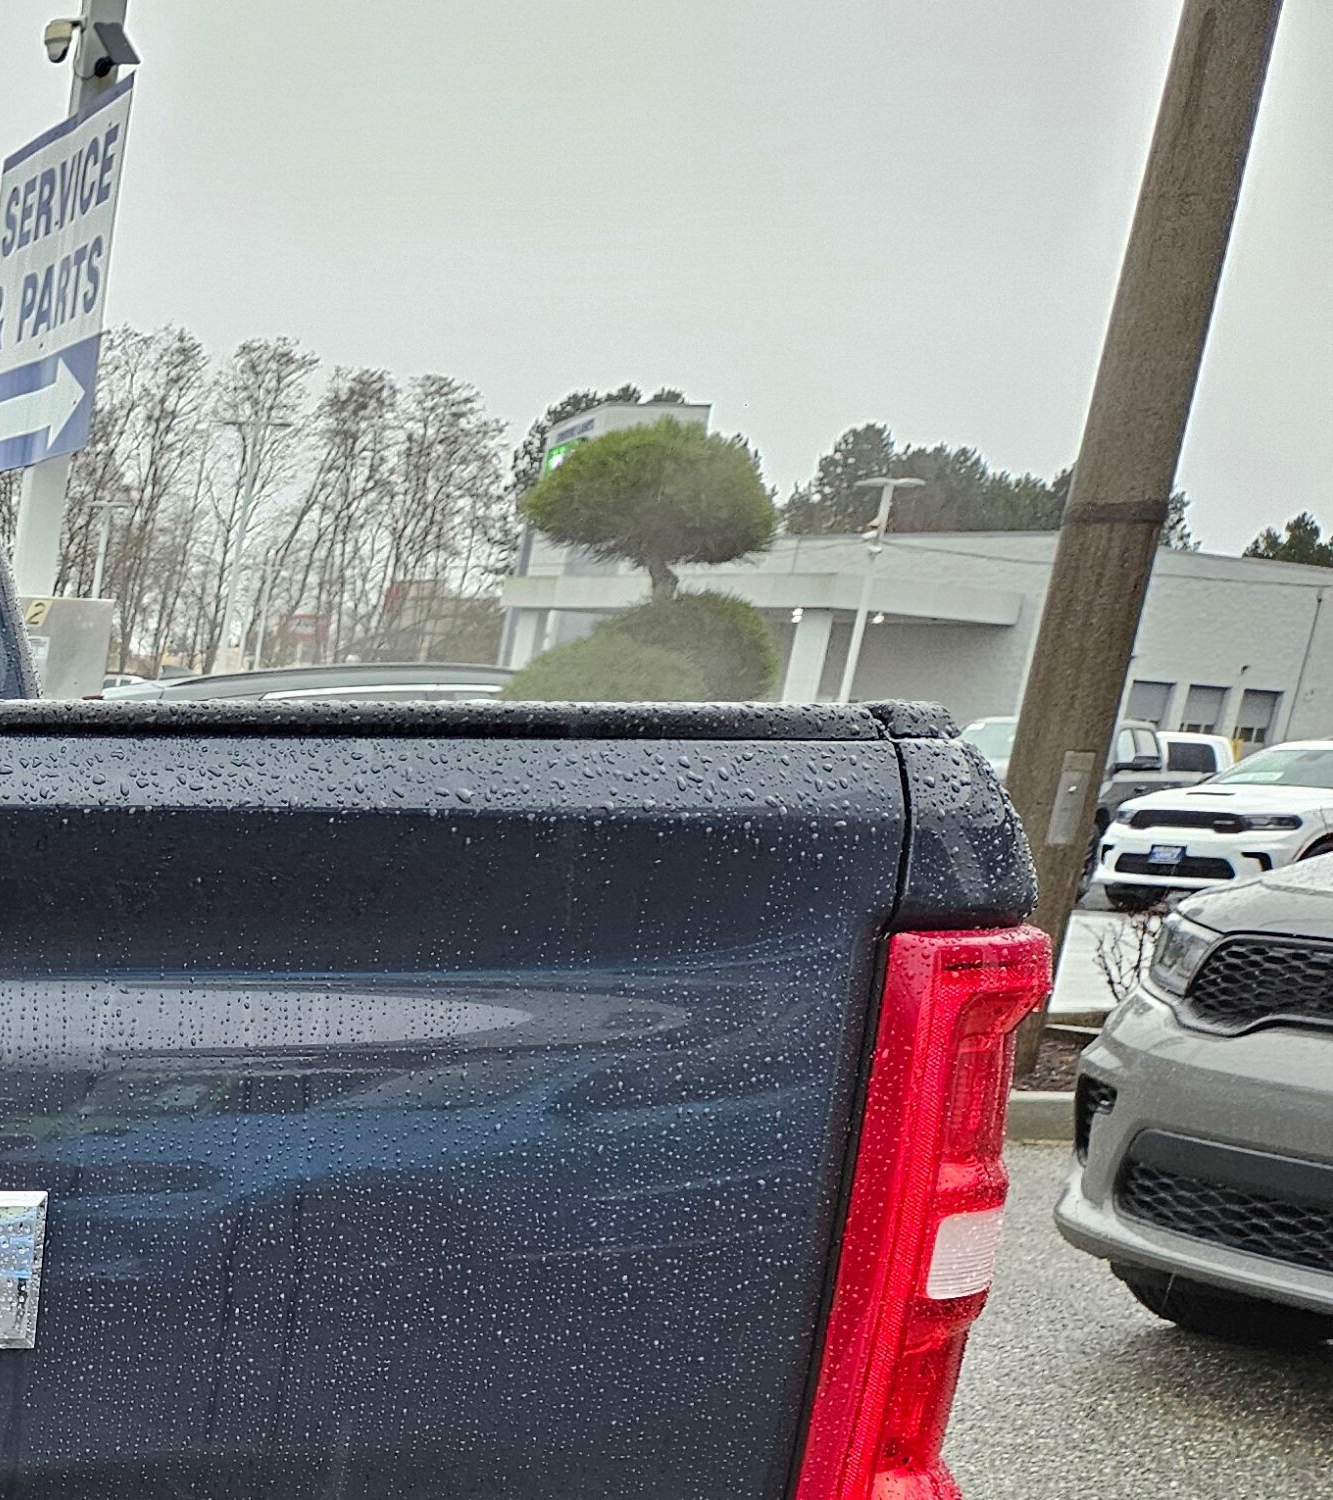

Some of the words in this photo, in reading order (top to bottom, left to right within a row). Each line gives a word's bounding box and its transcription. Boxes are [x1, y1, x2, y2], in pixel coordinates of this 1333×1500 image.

[2, 124, 119, 257] SERVICE
[17, 235, 103, 345] PARTS
[26, 602, 45, 625] 2
